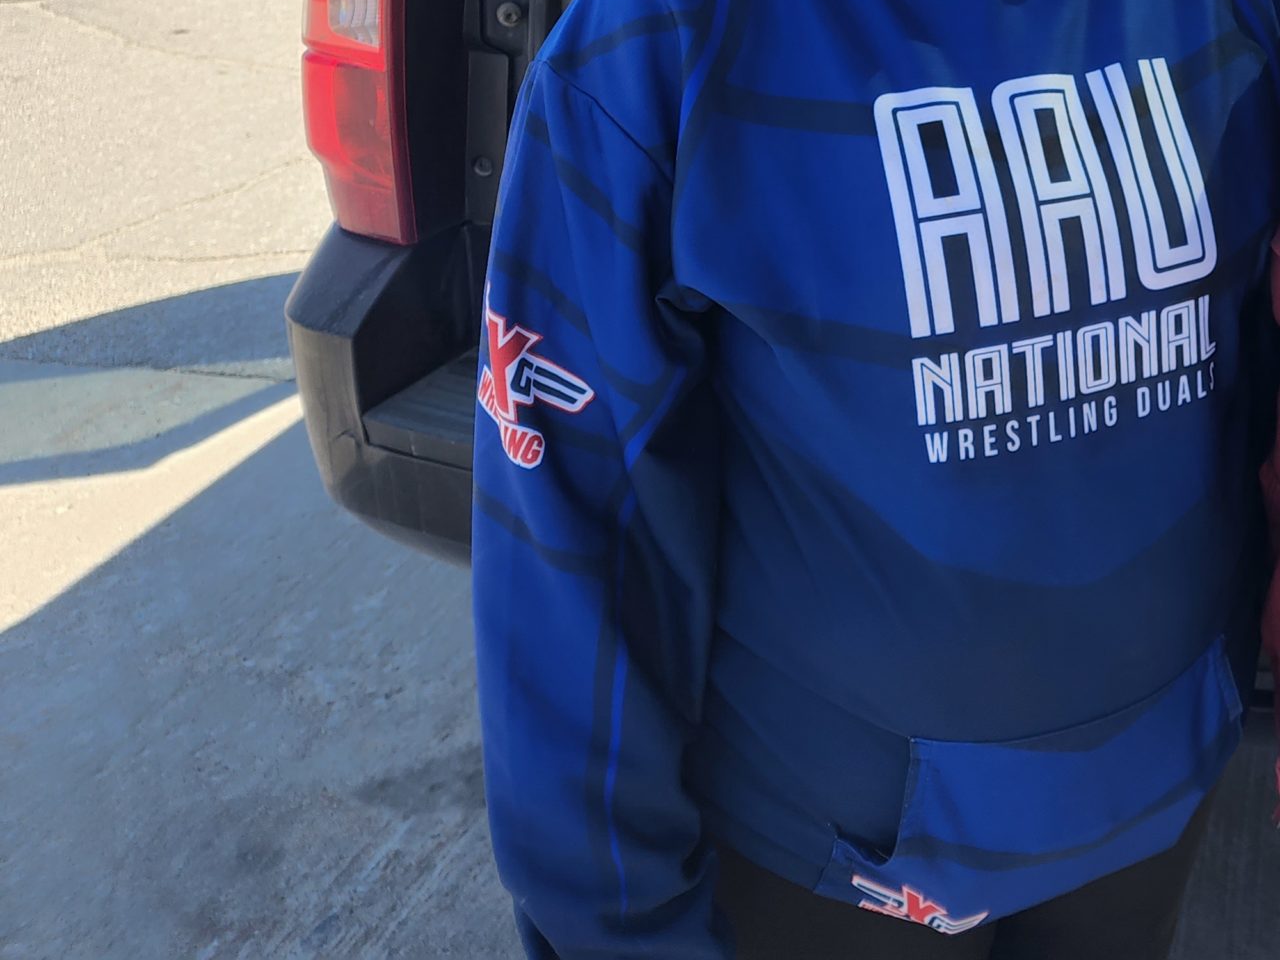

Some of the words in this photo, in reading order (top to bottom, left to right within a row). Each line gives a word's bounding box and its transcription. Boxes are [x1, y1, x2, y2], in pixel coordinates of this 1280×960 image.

[873, 57, 1217, 338] AAU
[911, 294, 1216, 426] NATIONAL
[925, 396, 1118, 463] WRESTLING
